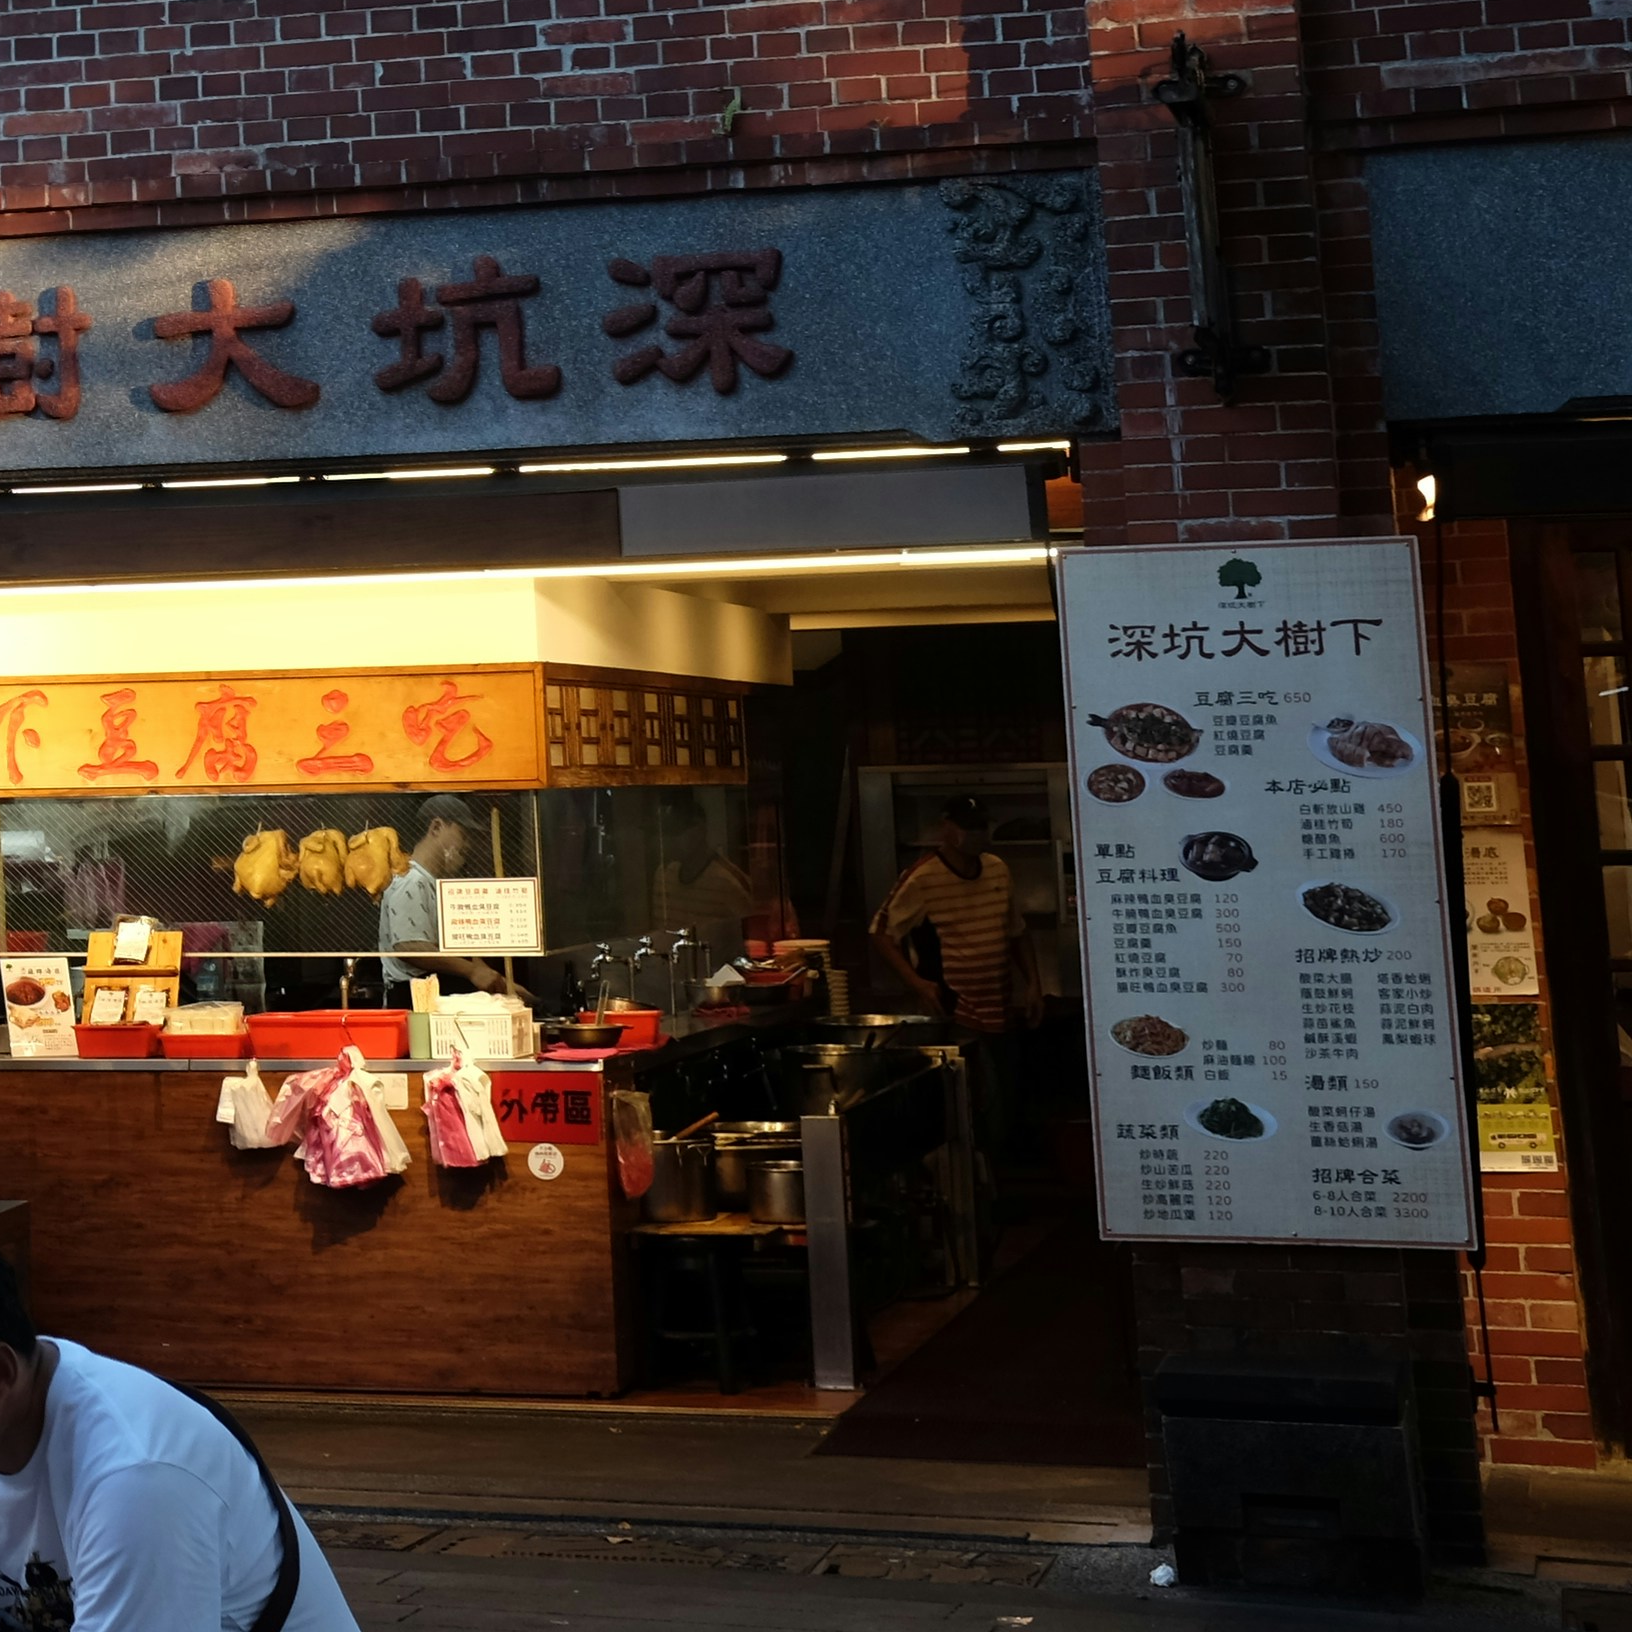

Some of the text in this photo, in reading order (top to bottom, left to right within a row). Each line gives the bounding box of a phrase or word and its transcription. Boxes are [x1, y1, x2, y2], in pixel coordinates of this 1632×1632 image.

[1107, 619, 1383, 662] 深坑大樹下
[1193, 691, 1312, 706] 豆腐三吃 650
[1264, 778, 1351, 795] 本店必點
[1377, 803, 1403, 814] 450
[1379, 818, 1404, 829] 180
[1379, 833, 1405, 844] 600
[1094, 843, 1136, 859] 單點
[1381, 848, 1407, 859] 170
[1095, 868, 1181, 884] 豆腐料理
[1215, 894, 1238, 904] 120
[1215, 908, 1240, 919] 300
[1215, 923, 1241, 934] 500
[1217, 938, 1242, 949] 150
[1227, 953, 1243, 963] 70
[1295, 948, 1412, 964] 招牌熱炒 200
[1227, 968, 1244, 978] 80
[1220, 983, 1245, 993] 300
[1269, 1041, 1286, 1051] 80
[1262, 1056, 1287, 1067] 100
[1272, 1070, 1287, 1081] 15
[1304, 1075, 1379, 1092] 湯類 150
[499, 1088, 593, 1125] 外帶區
[1116, 1124, 1180, 1141] 蔬菜類
[1203, 1150, 1229, 1161] 220
[1205, 1165, 1230, 1176] 220
[1312, 1168, 1401, 1185] 招牌合菜
[1205, 1180, 1231, 1191] 220
[1207, 1196, 1232, 1206] 120
[1313, 1191, 1428, 1203] 6-8人合菜 2200
[1208, 1210, 1233, 1221] 120
[1314, 1206, 1429, 1219] 8-10人合菜 3300
